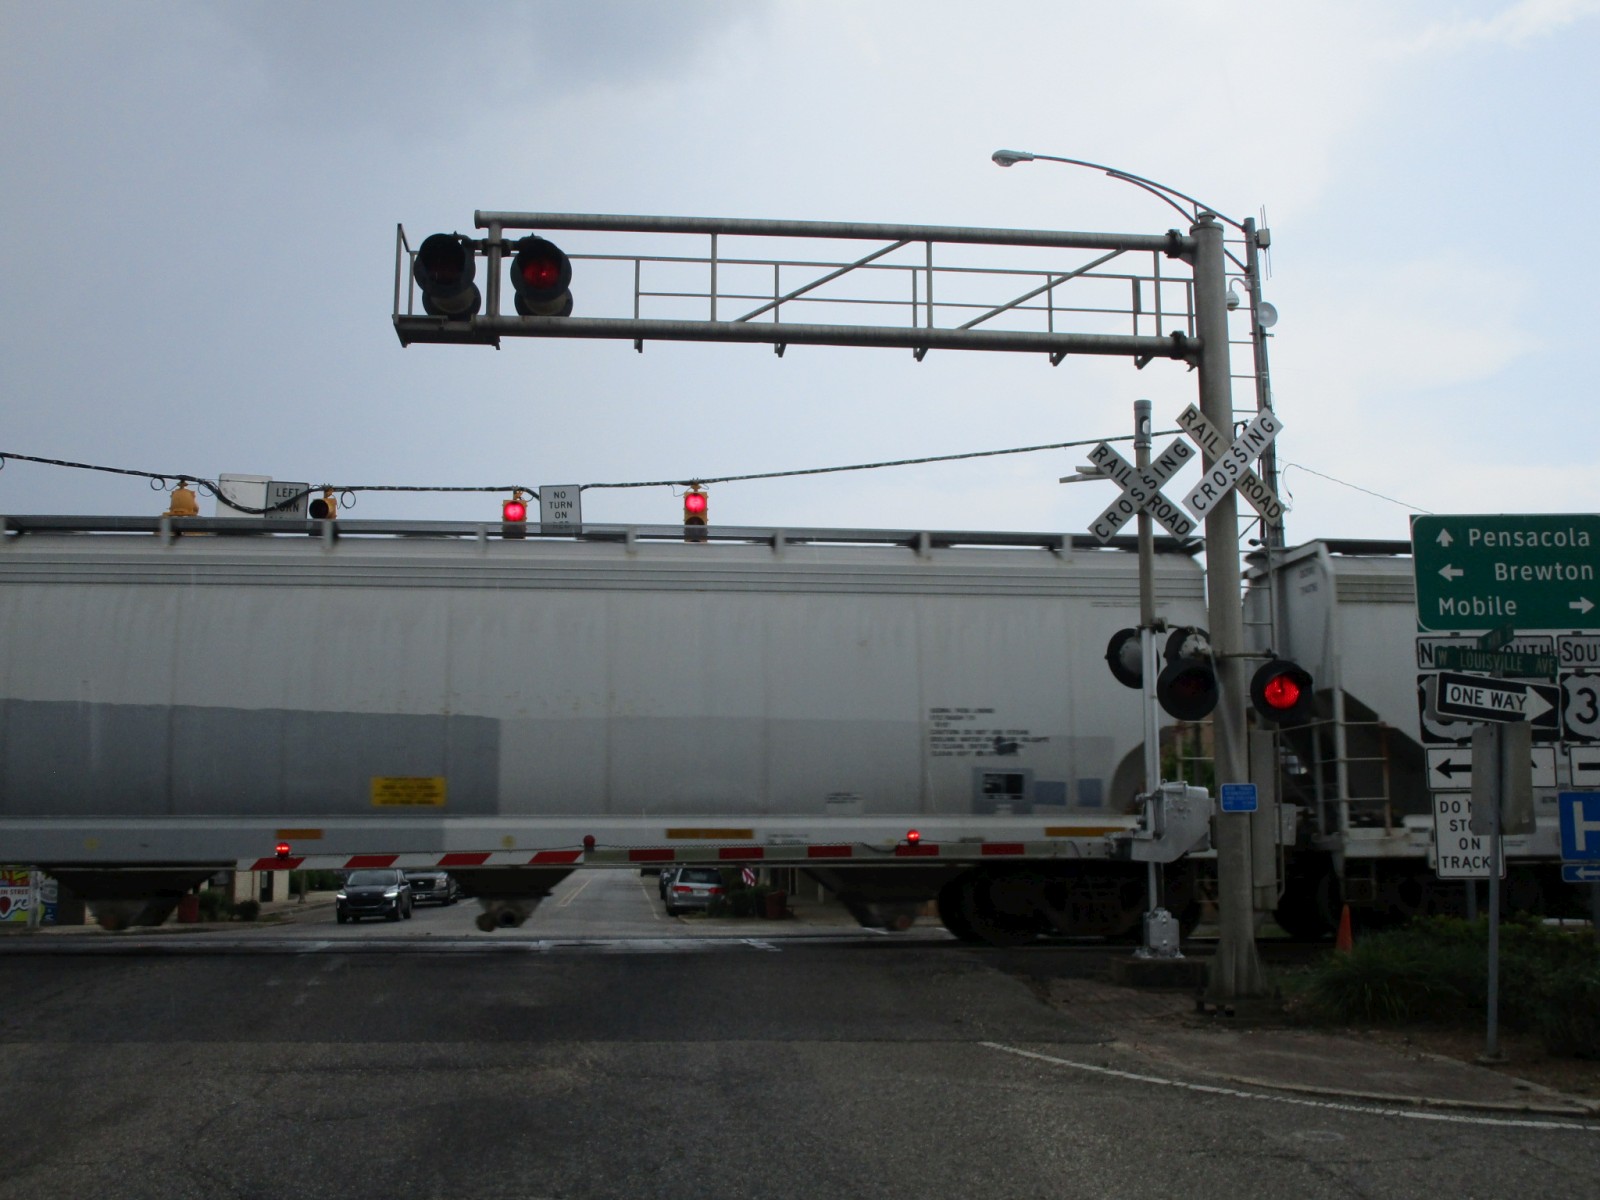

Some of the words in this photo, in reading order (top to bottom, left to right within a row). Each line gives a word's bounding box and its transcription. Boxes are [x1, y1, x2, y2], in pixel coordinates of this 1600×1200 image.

[1181, 408, 1217, 455] RAIL
[1241, 474, 1281, 519] ROAD
[1191, 417, 1275, 511] CROSSING
[276, 487, 300, 498] LEFT
[553, 490, 567, 499] NO
[1092, 445, 1133, 487] RAIL
[1147, 495, 1191, 536] ROAD
[1094, 442, 1189, 539] CROSSING
[548, 501, 573, 509] TURN
[554, 511, 568, 519] ON
[1468, 527, 1591, 547] Pensacola
[1494, 562, 1594, 581] Brewton
[1438, 596, 1517, 616] Mobile
[1438, 650, 1448, 666] W
[1460, 651, 1523, 672] LOUISVILLE
[1535, 657, 1555, 673] AVE
[1562, 641, 1600, 662] SOU
[1451, 686, 1484, 706] ONE
[1490, 691, 1528, 711] WAY
[1576, 687, 1599, 724] 3
[1440, 800, 1461, 814] DO
[1459, 837, 1481, 850] ON
[1441, 855, 1491, 869] TRACK
